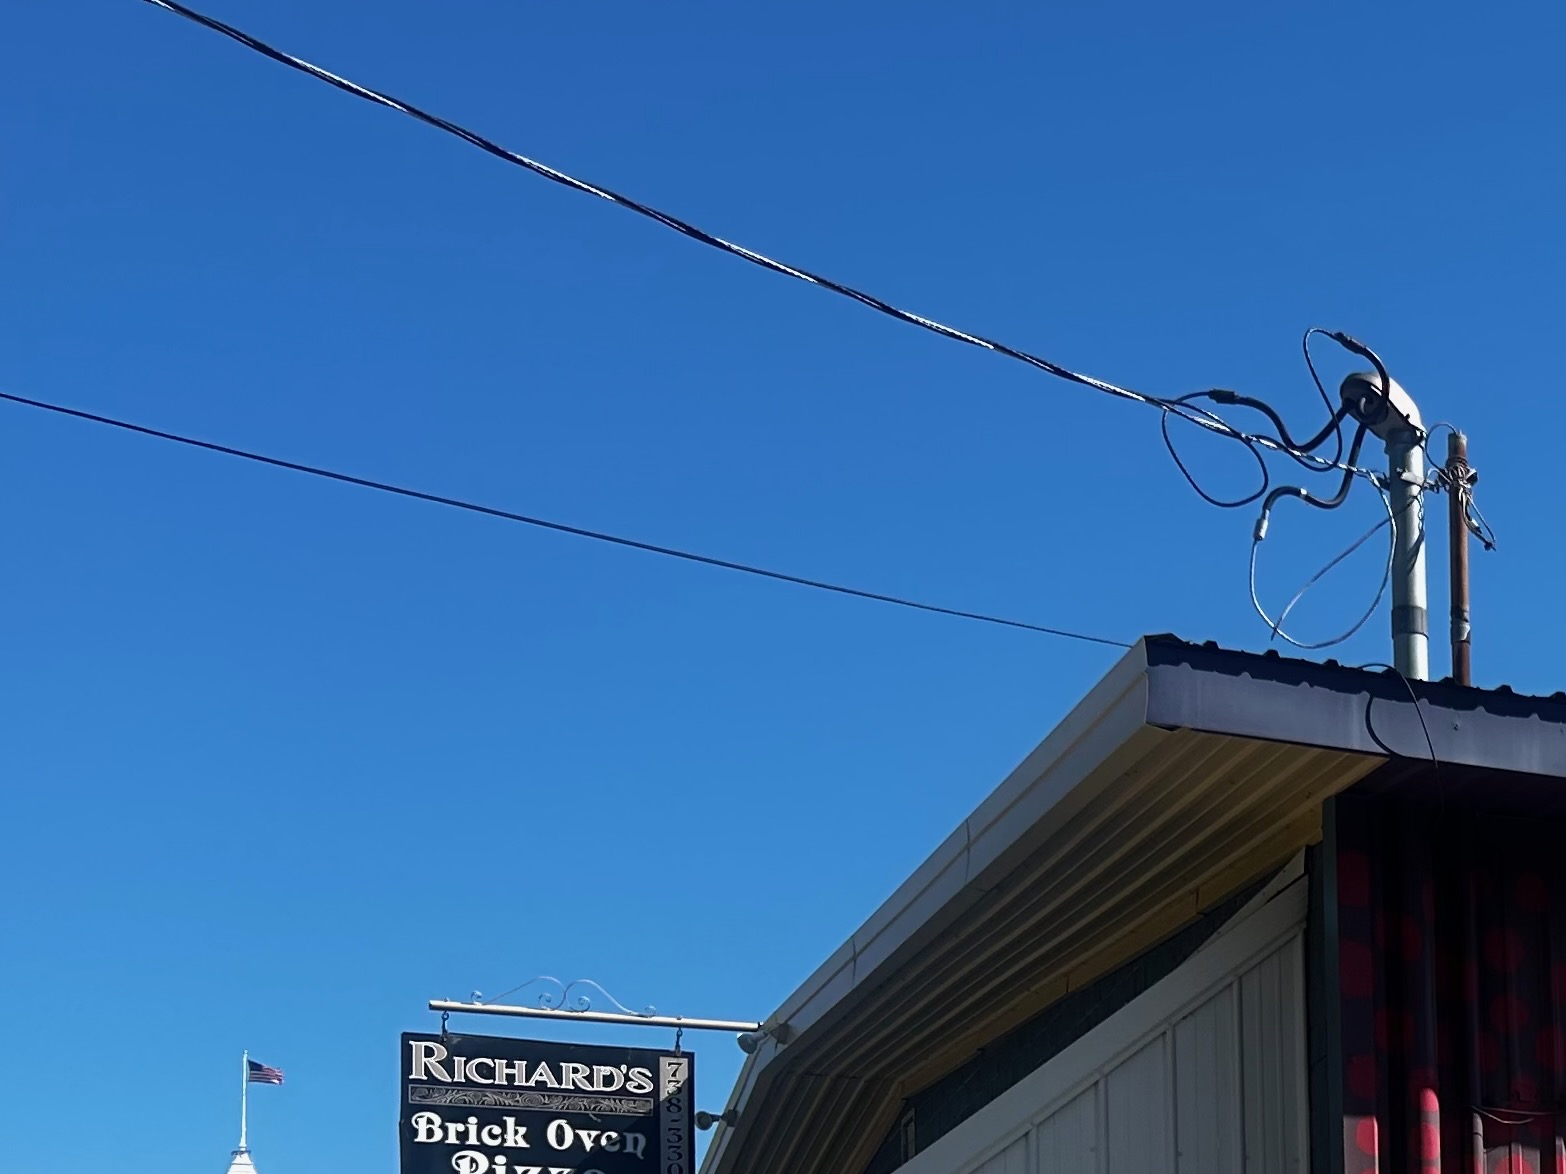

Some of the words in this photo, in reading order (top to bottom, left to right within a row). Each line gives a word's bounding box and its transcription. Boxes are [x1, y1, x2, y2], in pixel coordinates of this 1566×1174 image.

[408, 1040, 654, 1094] RICHARD'S
[411, 1111, 530, 1148] Brick
[546, 1118, 647, 1160] Oven
